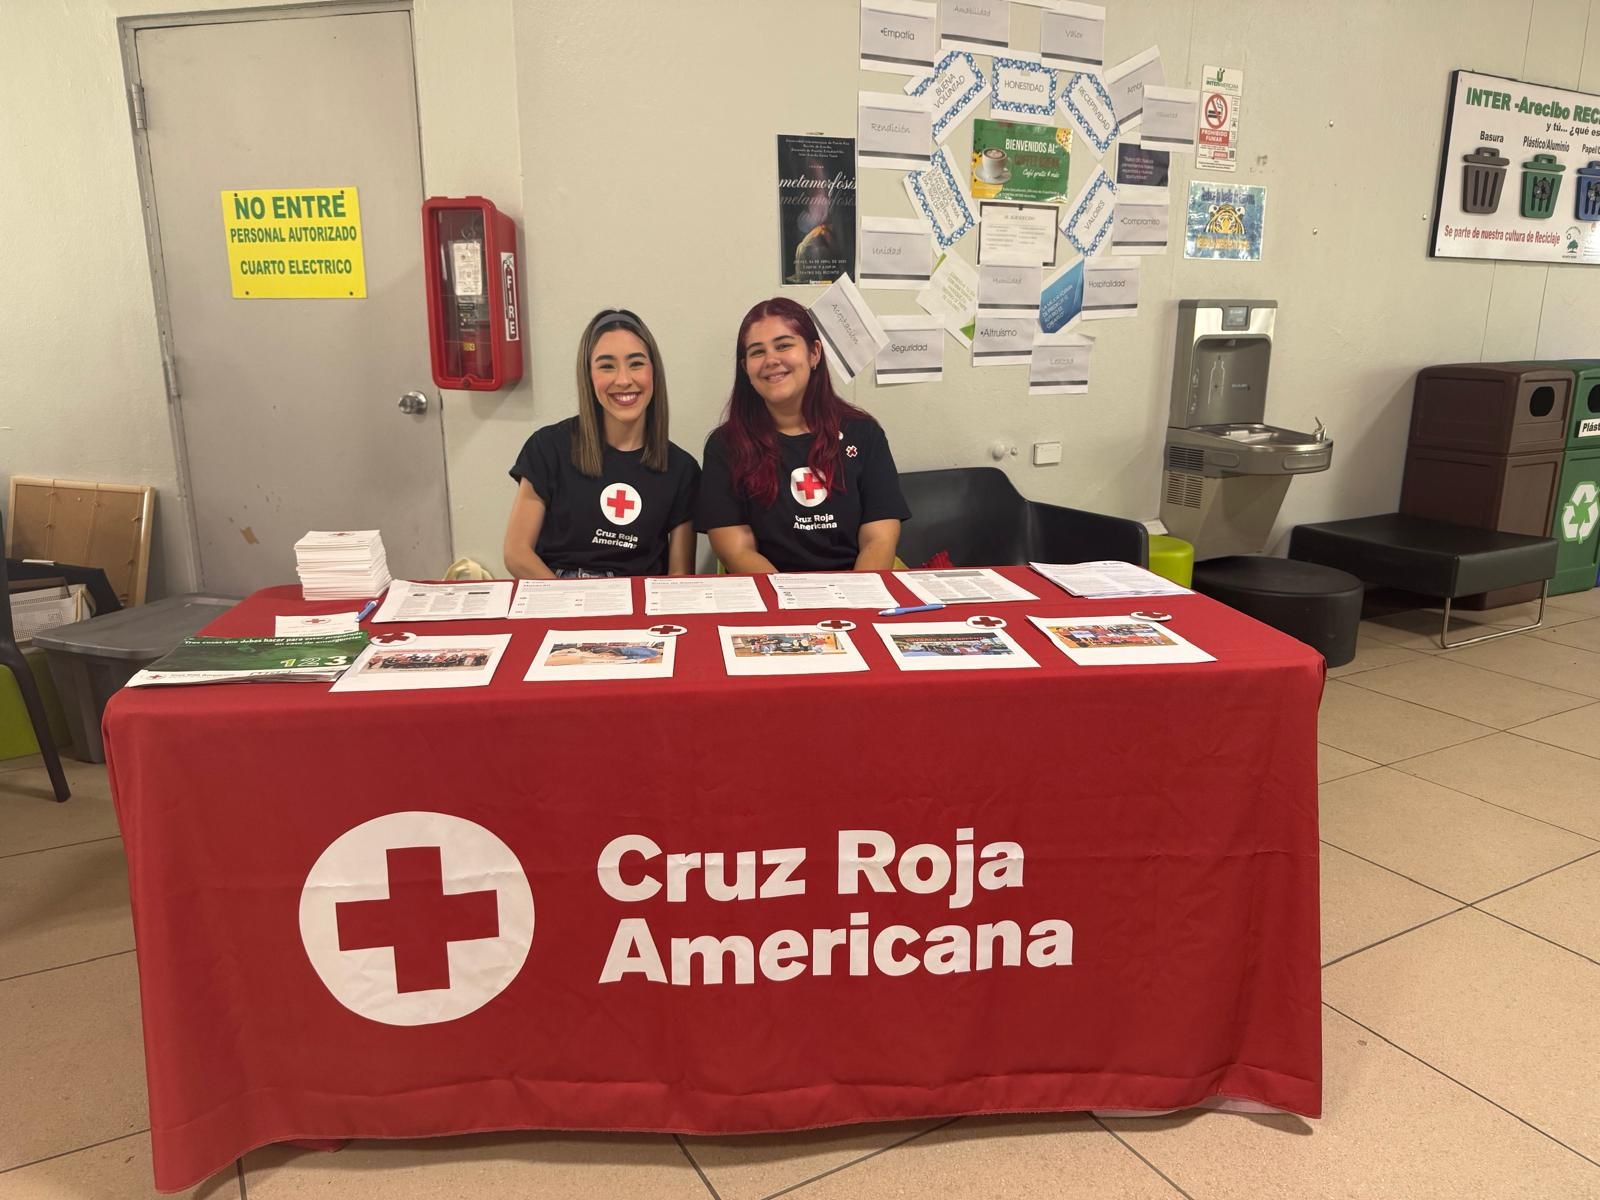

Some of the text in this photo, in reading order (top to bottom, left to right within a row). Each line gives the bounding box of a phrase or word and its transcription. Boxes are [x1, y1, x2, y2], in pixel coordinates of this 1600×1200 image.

[933, 75, 966, 109] VOLUNTAD
[935, 73, 956, 97] BUENA
[1004, 80, 1045, 93] HONESTIDAD
[1078, 86, 1111, 131] RECEPTIVIDAD
[1466, 87, 1512, 111] INTER
[1573, 104, 1600, 125] REC
[1480, 130, 1504, 143] Basura
[1545, 122, 1552, 132] y
[1569, 126, 1589, 137] ¿qué
[1005, 138, 1047, 154] BIENVENIDOS
[234, 194, 347, 220] NO ENTRE
[1084, 199, 1105, 230] VALORES
[230, 225, 357, 243] PERSONAL AUTORIZADO
[1444, 225, 1561, 247] Se parte de nuestra cultura de Reciclaje
[240, 259, 352, 275] CUARTO ELECTRICO
[1088, 279, 1126, 289] Hospitalidad
[506, 274, 516, 335] FIRE
[983, 328, 1017, 337] Altruismo
[891, 344, 928, 354] Seguridad
[813, 513, 834, 522] Roja
[793, 522, 838, 531] Americana
[595, 528, 639, 543] Cruz Roja
[280, 655, 348, 668] 1 2 3
[597, 827, 1025, 909] Cruz Roja
[598, 911, 1074, 986] Americana
